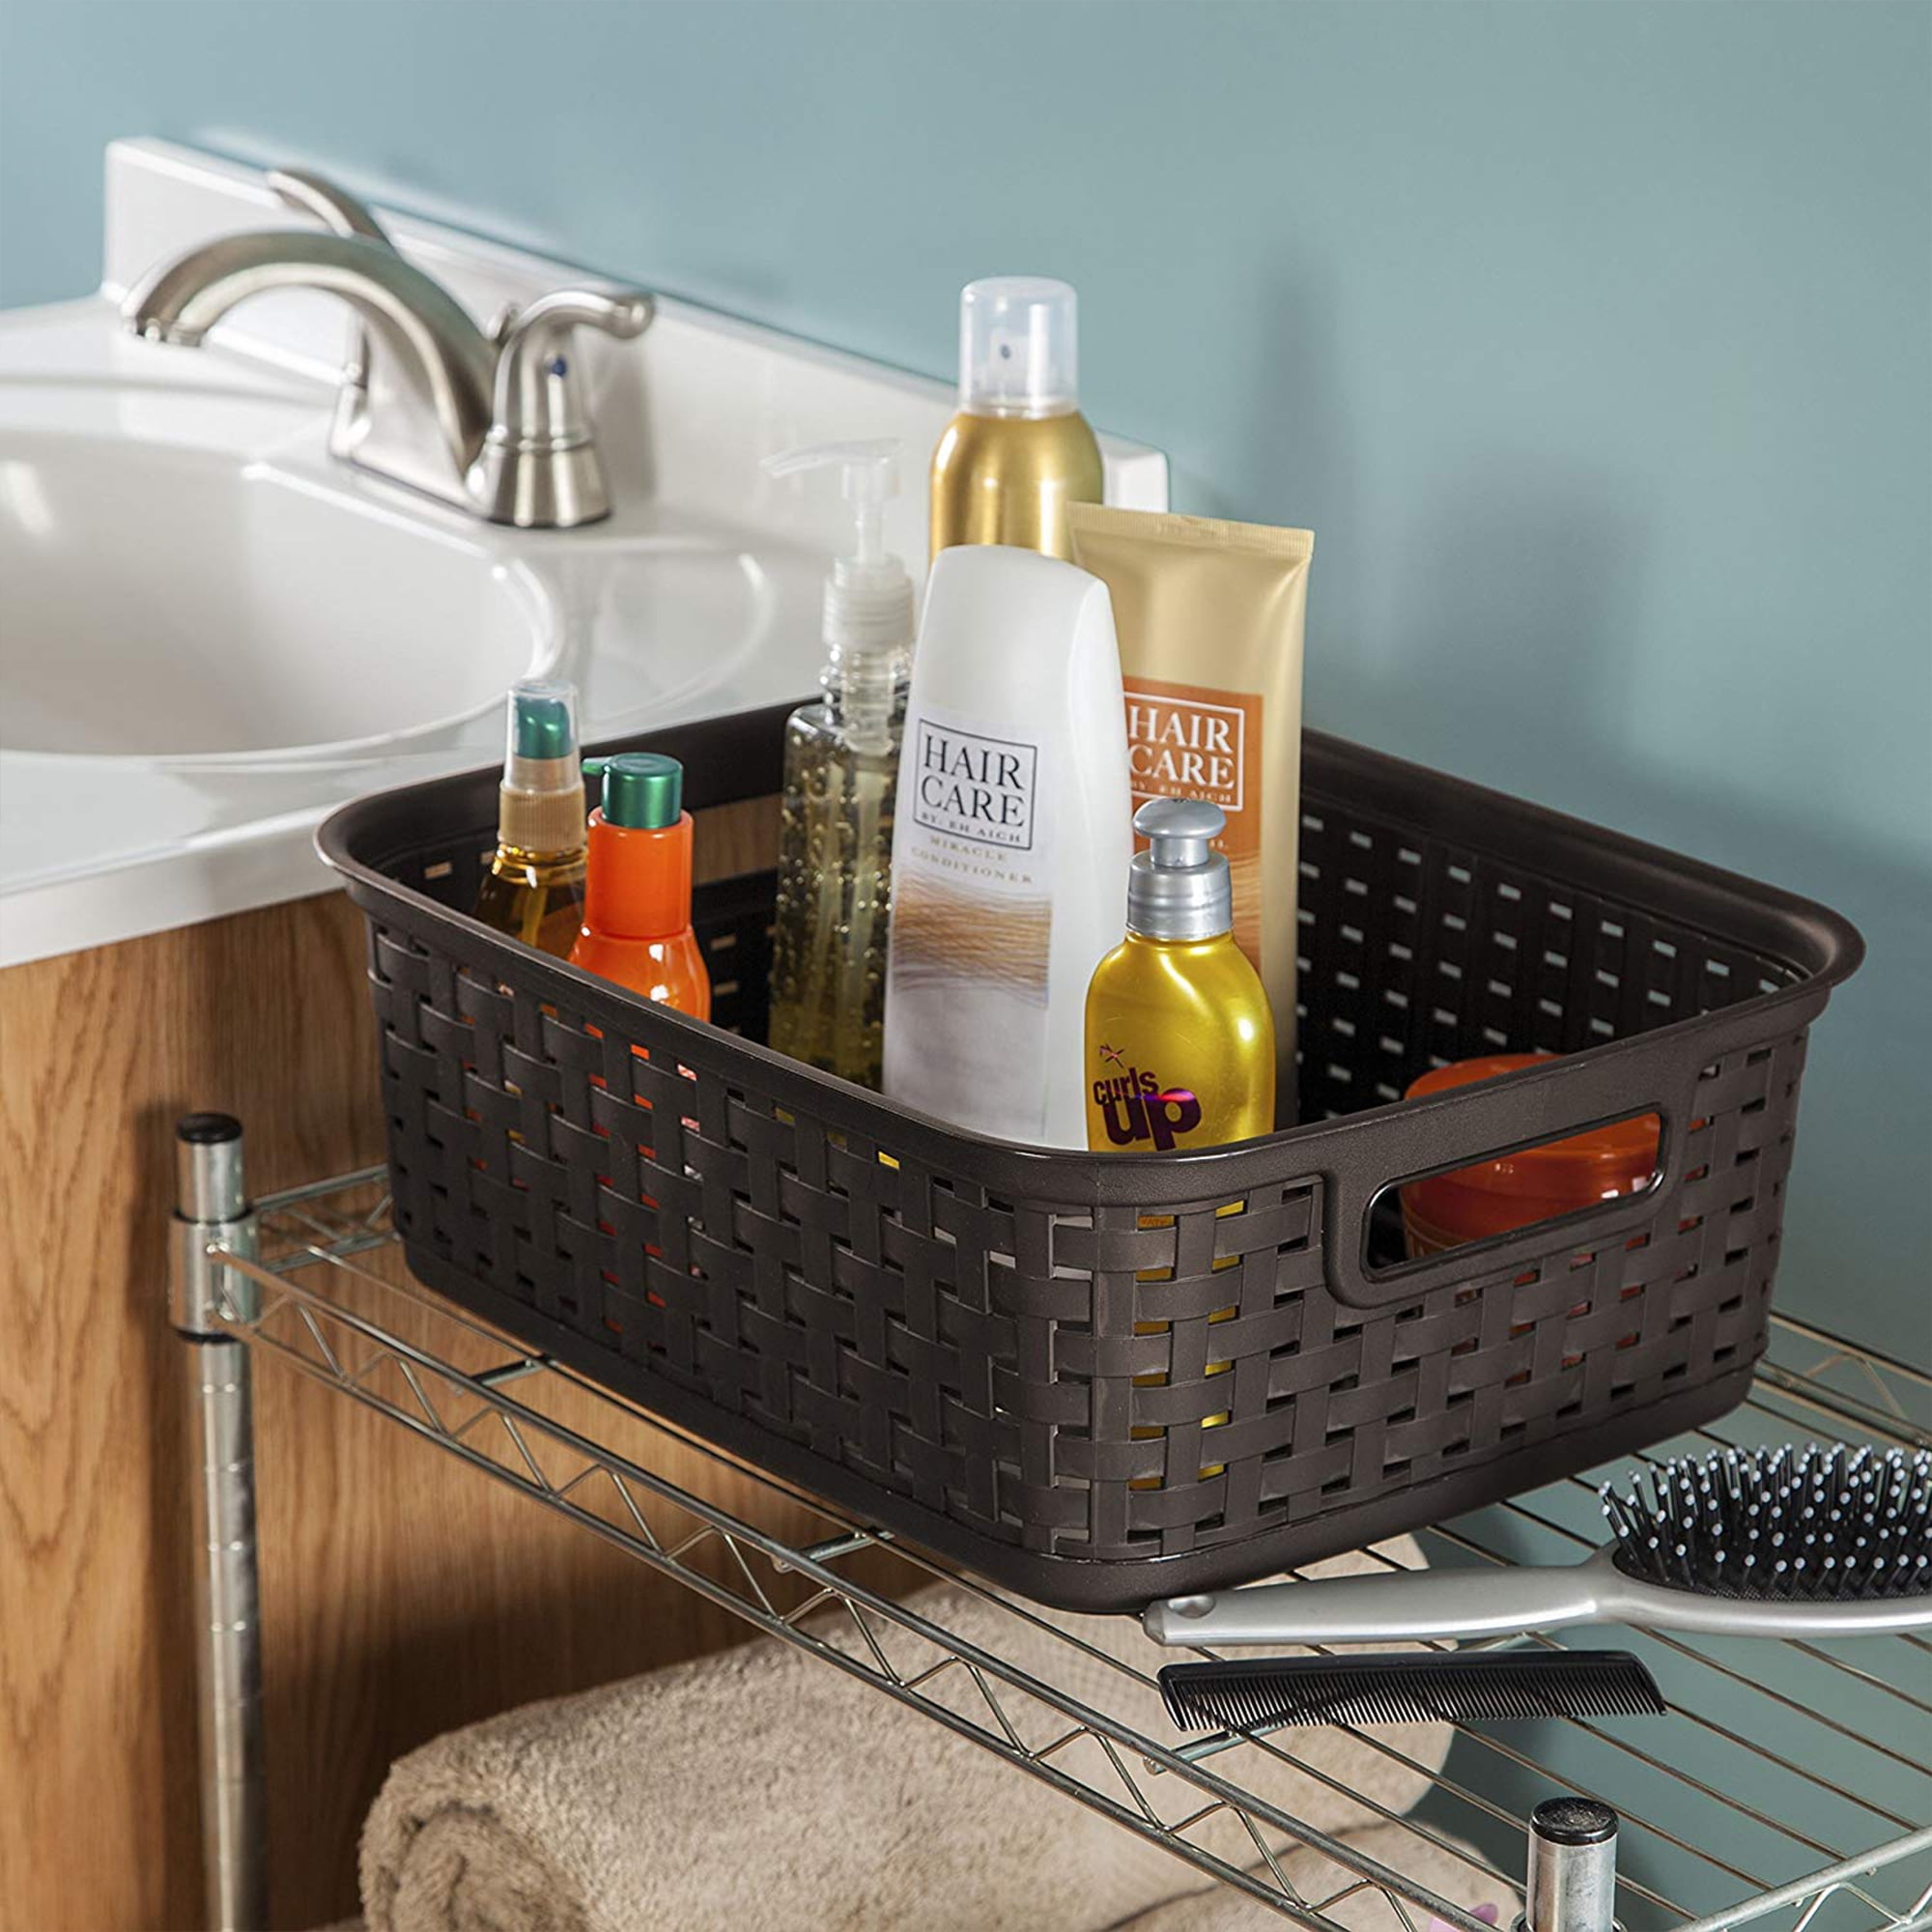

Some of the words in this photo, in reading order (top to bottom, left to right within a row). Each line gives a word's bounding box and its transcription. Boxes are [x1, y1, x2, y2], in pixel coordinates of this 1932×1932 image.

[1128, 704, 1234, 754] HAIR
[923, 733, 1026, 791] HAIR
[1128, 743, 1236, 790] CARE
[921, 774, 1026, 828] CARE
[911, 845, 1033, 884] CONDITIONER
[930, 834, 1008, 862] MIRACLE
[1093, 1066, 1159, 1106] curls
[1101, 1087, 1202, 1151] up
